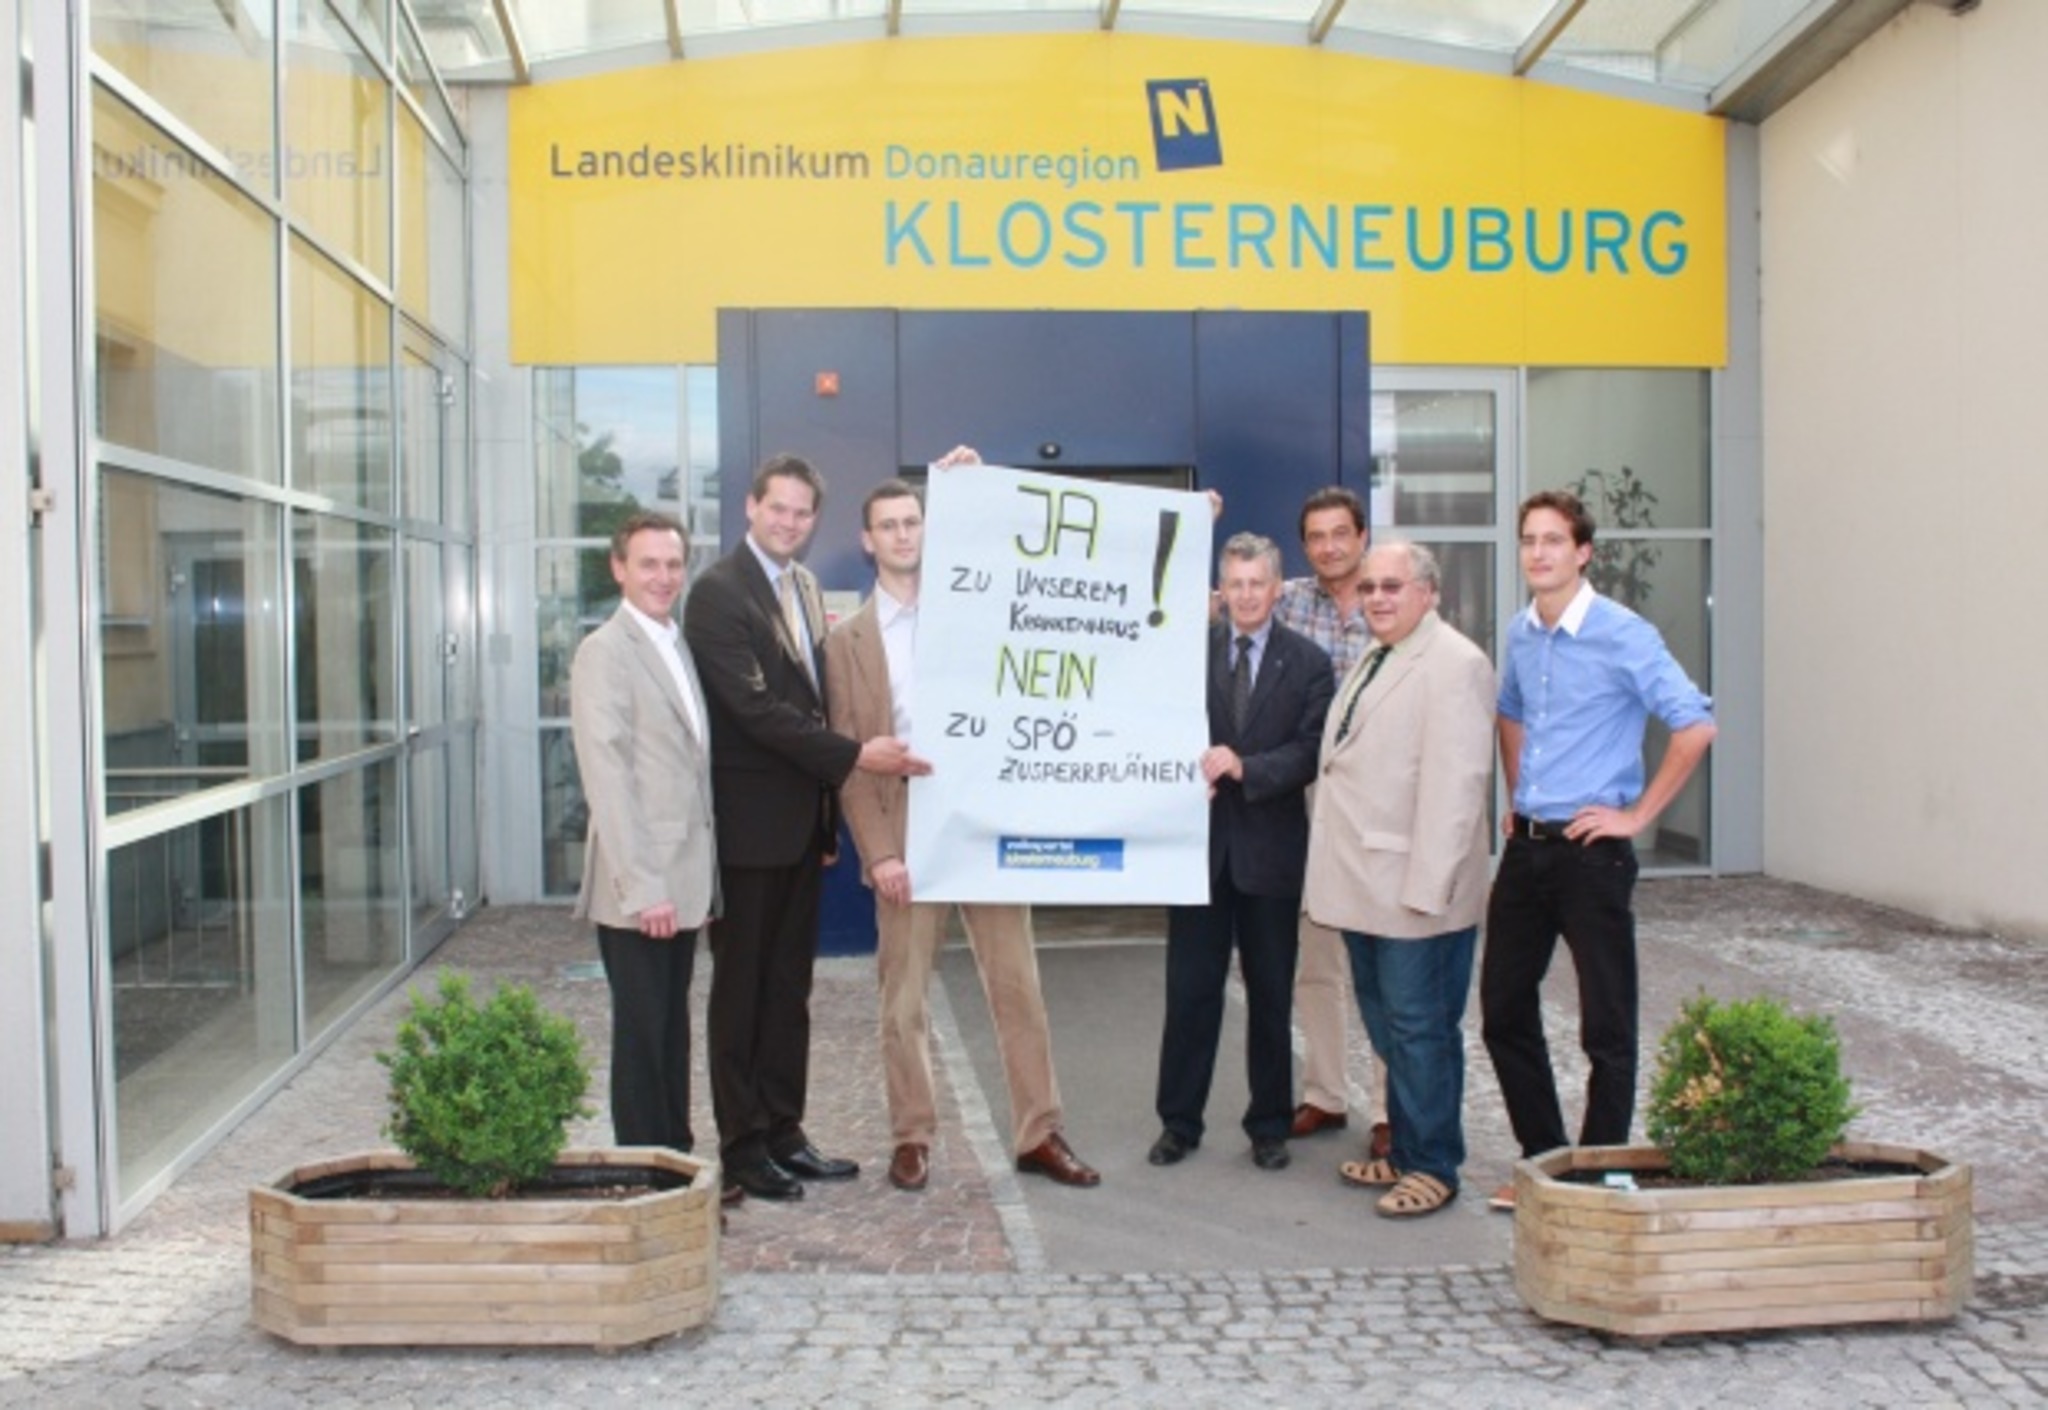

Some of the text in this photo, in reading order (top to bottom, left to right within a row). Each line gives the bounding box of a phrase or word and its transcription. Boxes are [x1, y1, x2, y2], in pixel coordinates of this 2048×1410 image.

[1156, 88, 1210, 137] N
[550, 143, 1139, 188] Landesklinikum Donauregion
[884, 199, 1688, 275] KLOSTERNEUBURG
[1015, 484, 1099, 560] JA
[950, 566, 1128, 607] ZU UNSEREM
[997, 645, 1097, 700] NEIN
[945, 712, 986, 738] ZU
[1007, 711, 1078, 751] SPÖ
[996, 753, 1196, 784] ZUSPERRPLÄNEN
